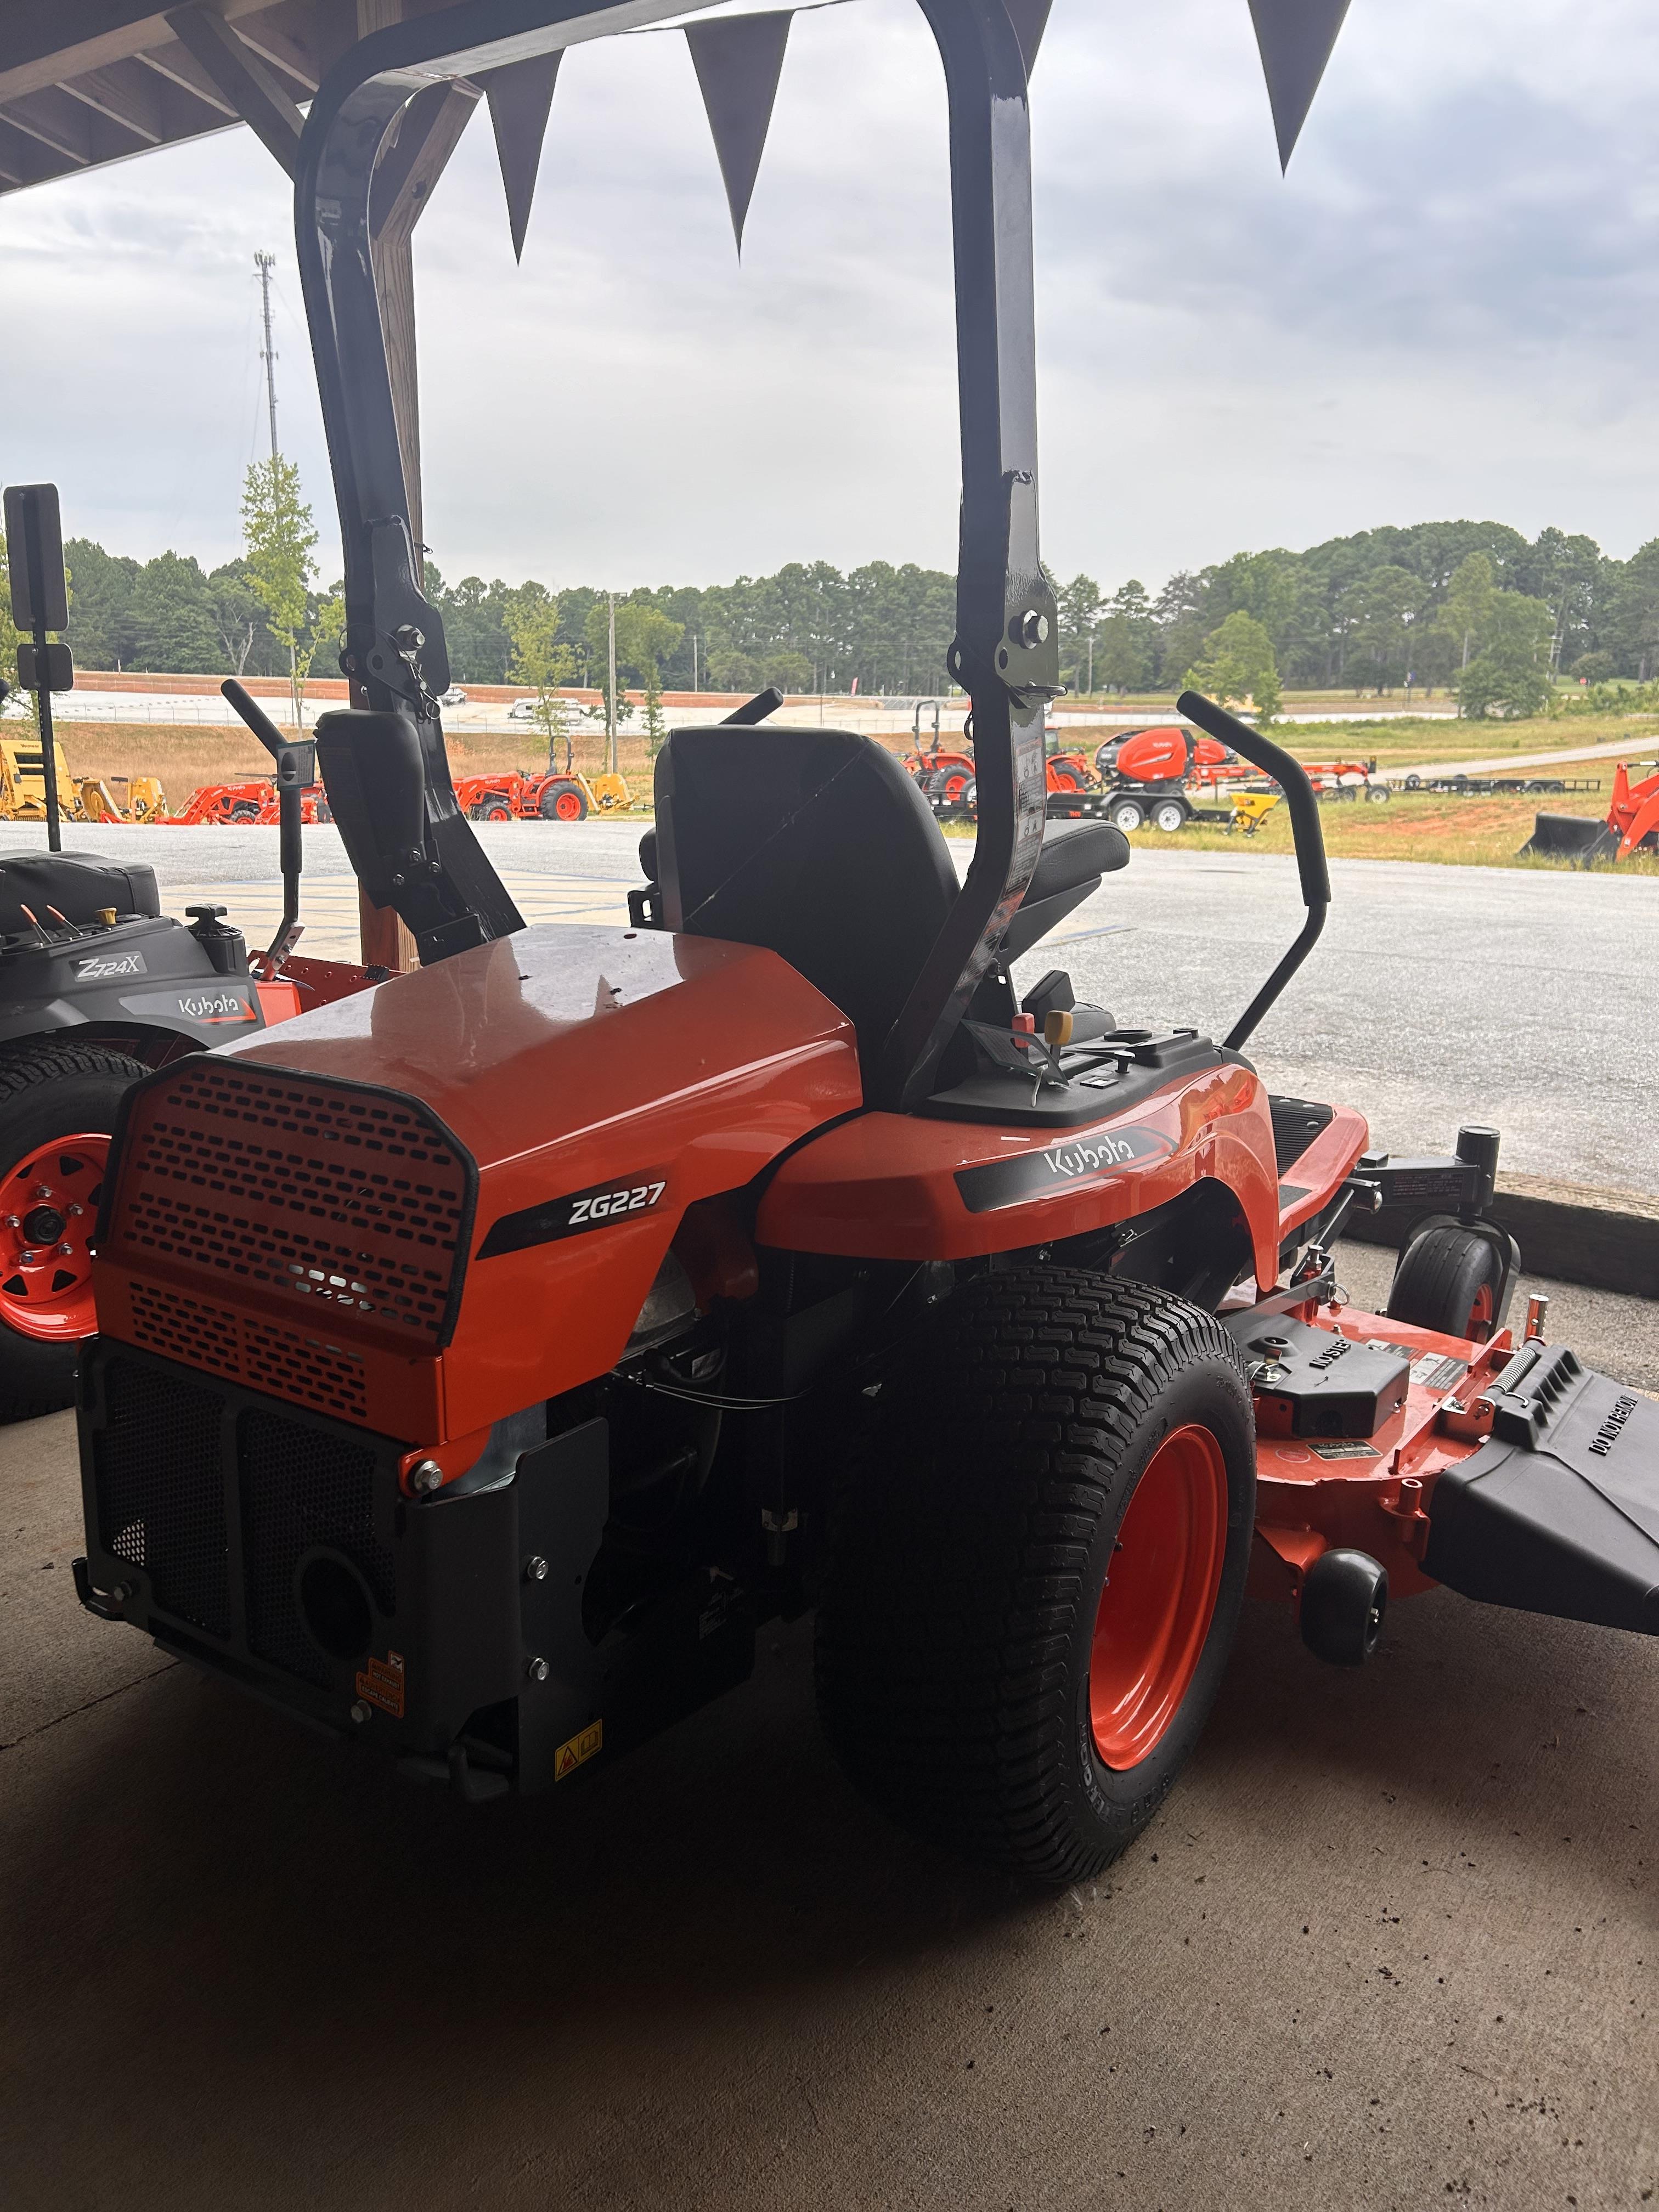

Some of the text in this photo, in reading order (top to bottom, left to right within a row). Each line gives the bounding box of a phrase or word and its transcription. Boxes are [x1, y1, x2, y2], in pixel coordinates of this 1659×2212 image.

[77, 955, 139, 978] Z724X
[178, 994, 239, 1016] Kubota
[1043, 1136, 1135, 1176] Kubota
[568, 1181, 667, 1226] ZG227
[1309, 1355, 1333, 1369] NO
[1598, 1419, 1622, 1441] NOT
[1589, 1436, 1612, 1456] DO
